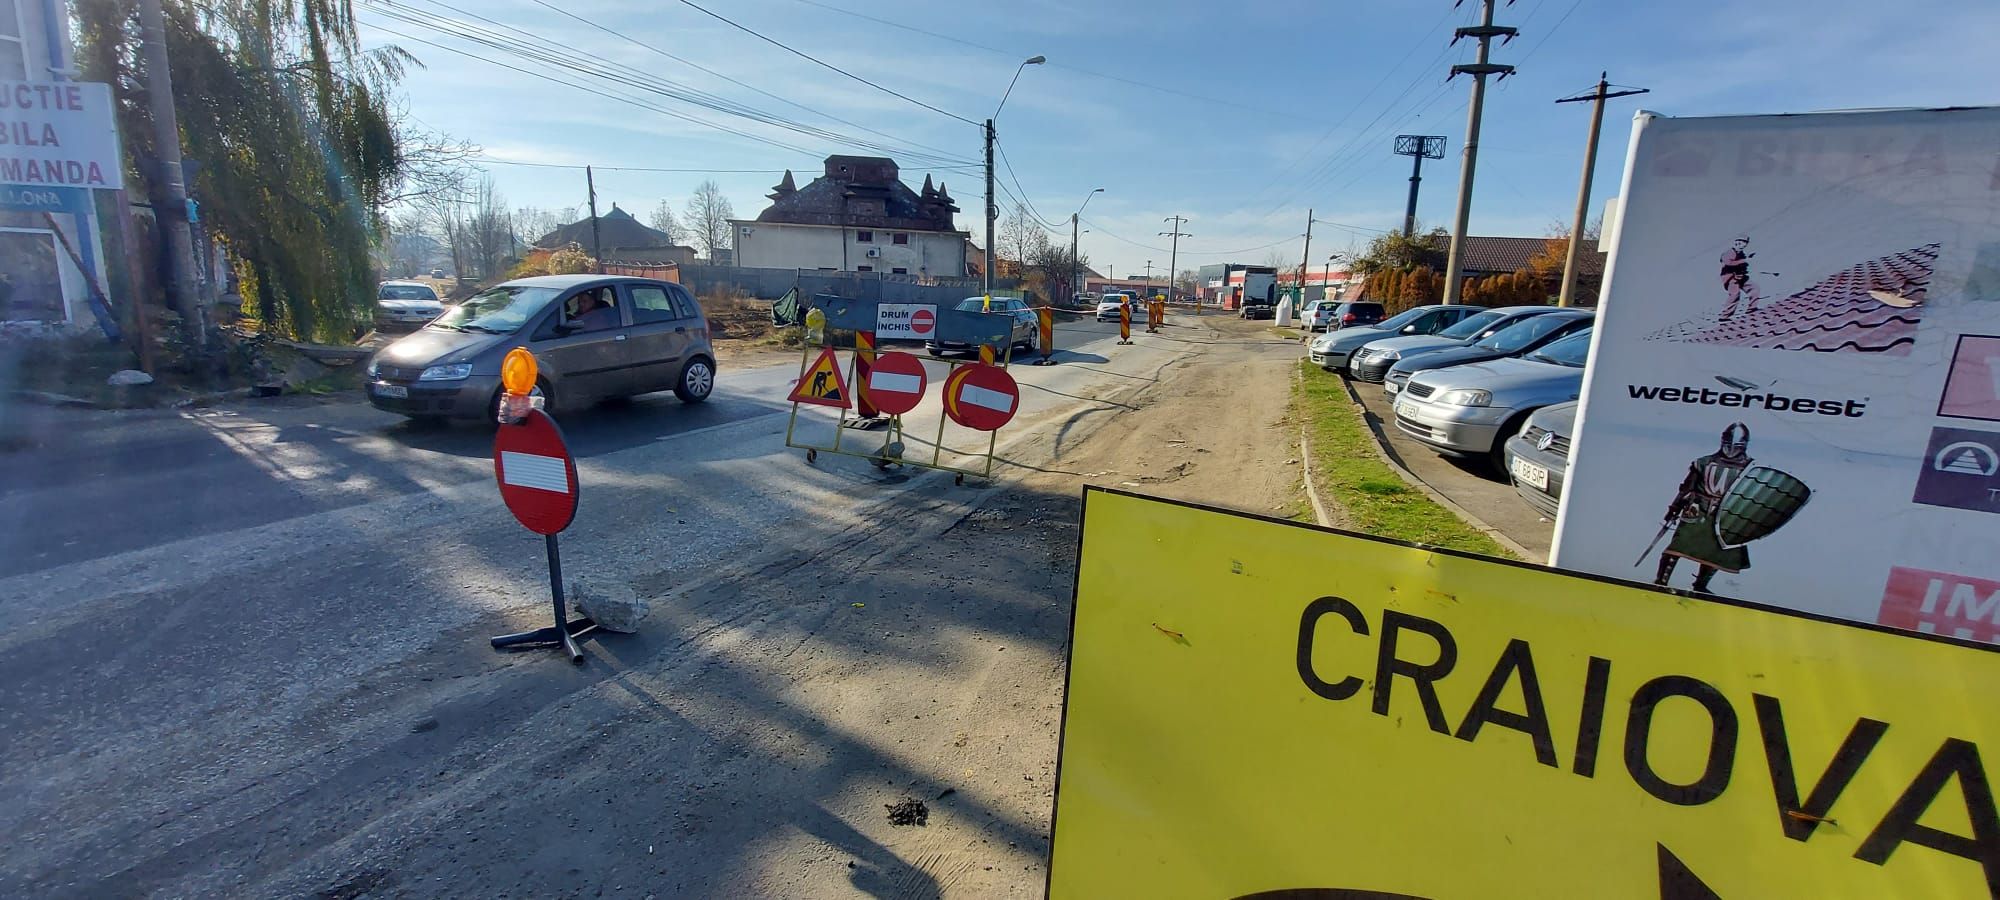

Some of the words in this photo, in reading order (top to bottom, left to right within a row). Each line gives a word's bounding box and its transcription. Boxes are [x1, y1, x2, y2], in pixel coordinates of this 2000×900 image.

[0, 158, 106, 185] MANDA
[881, 311, 909, 319] DRUM
[1628, 384, 1867, 418] wetterbest
[1296, 596, 2000, 900] CRAIOVA
